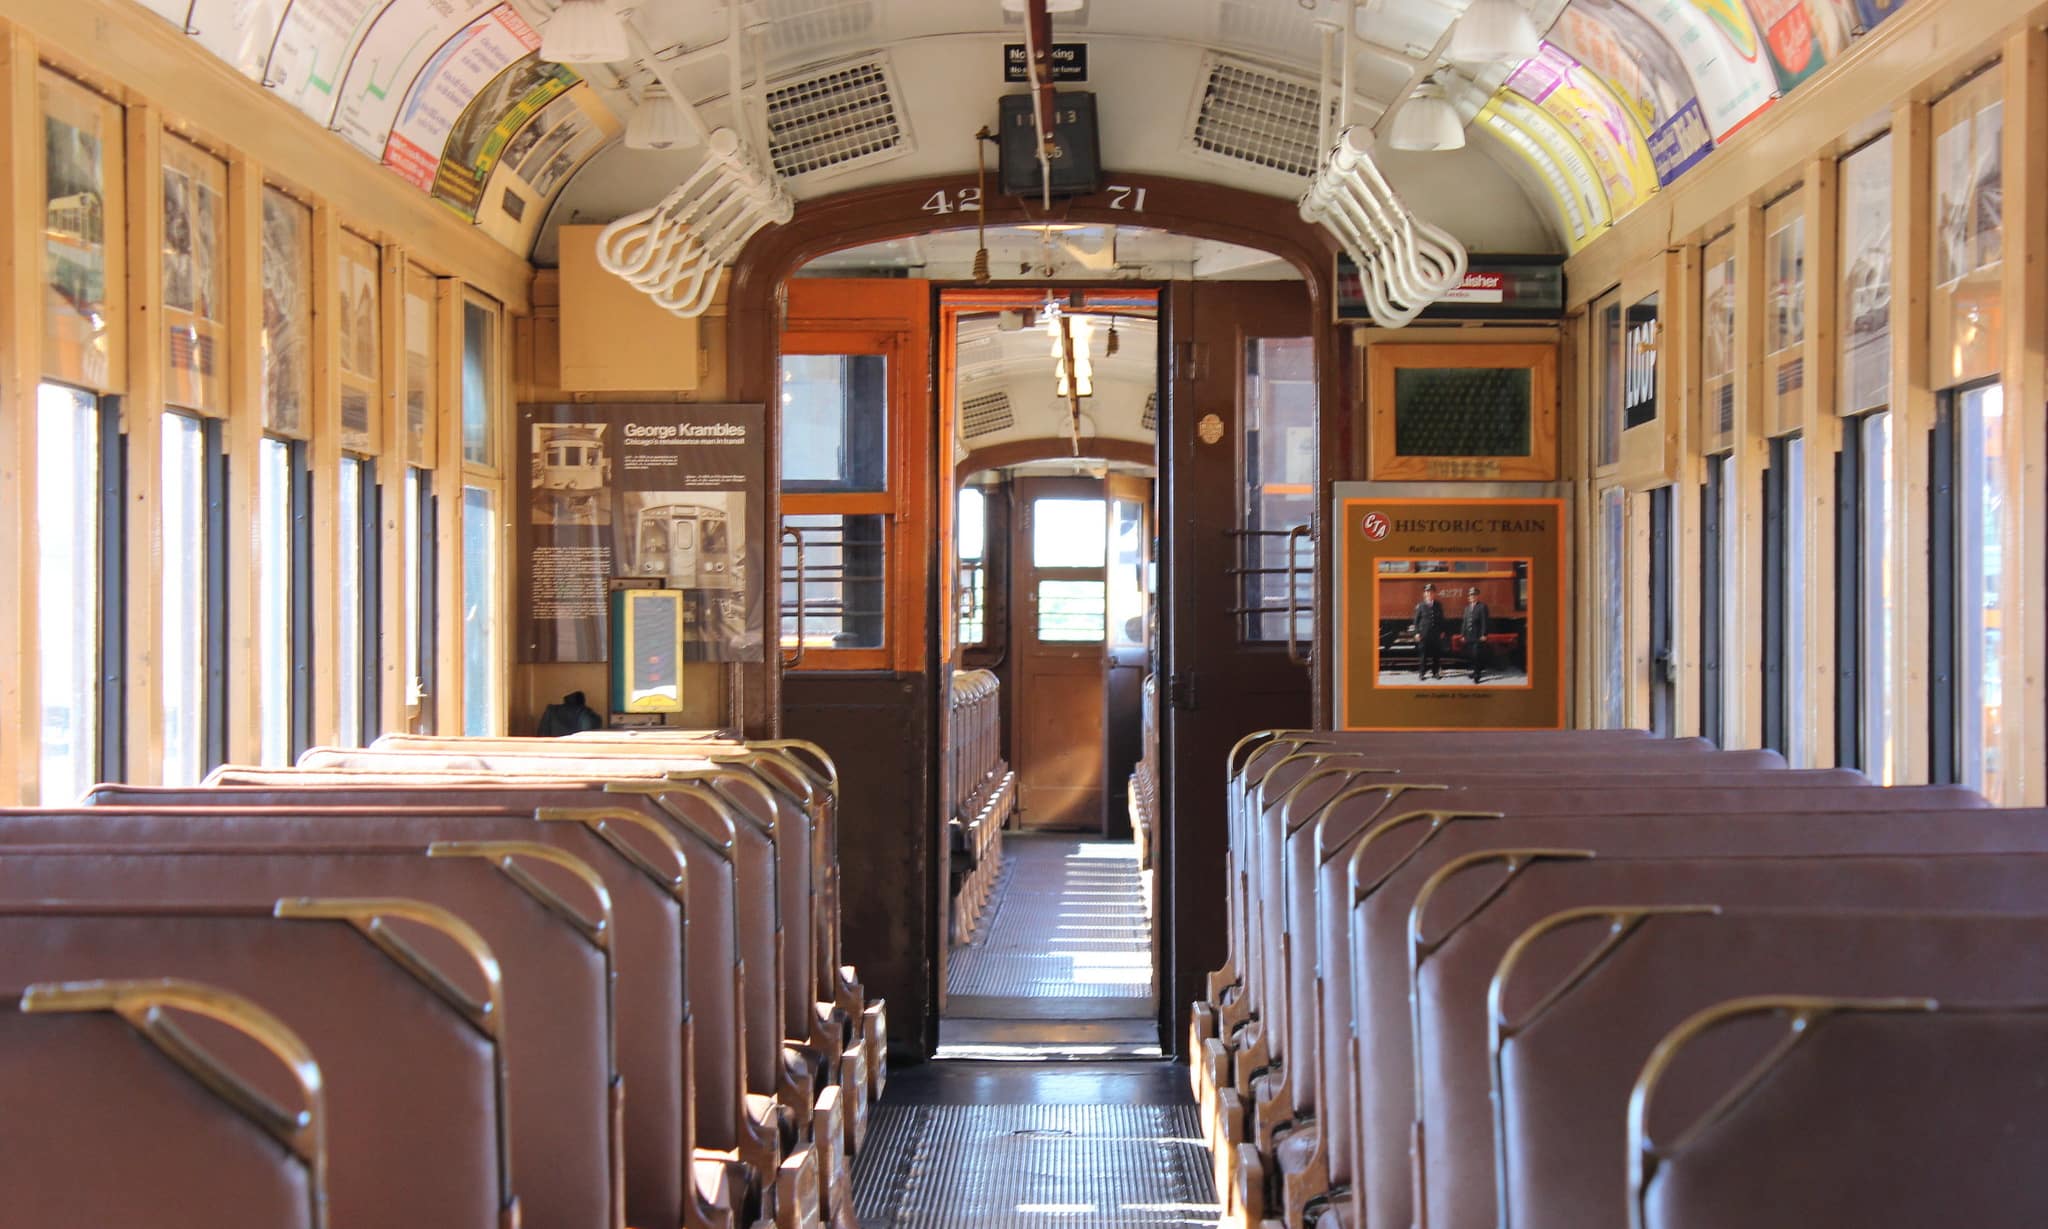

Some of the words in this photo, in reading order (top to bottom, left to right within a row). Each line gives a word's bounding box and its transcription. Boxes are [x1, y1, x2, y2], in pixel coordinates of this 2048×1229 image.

[1009, 49, 1026, 60] No
[1107, 185, 1147, 212] 71
[624, 423, 677, 439] George
[679, 422, 746, 437] Krambles
[1364, 513, 1388, 539] CTA
[1395, 519, 1483, 533] HISTORIC
[1486, 519, 1546, 533] TRAIN
